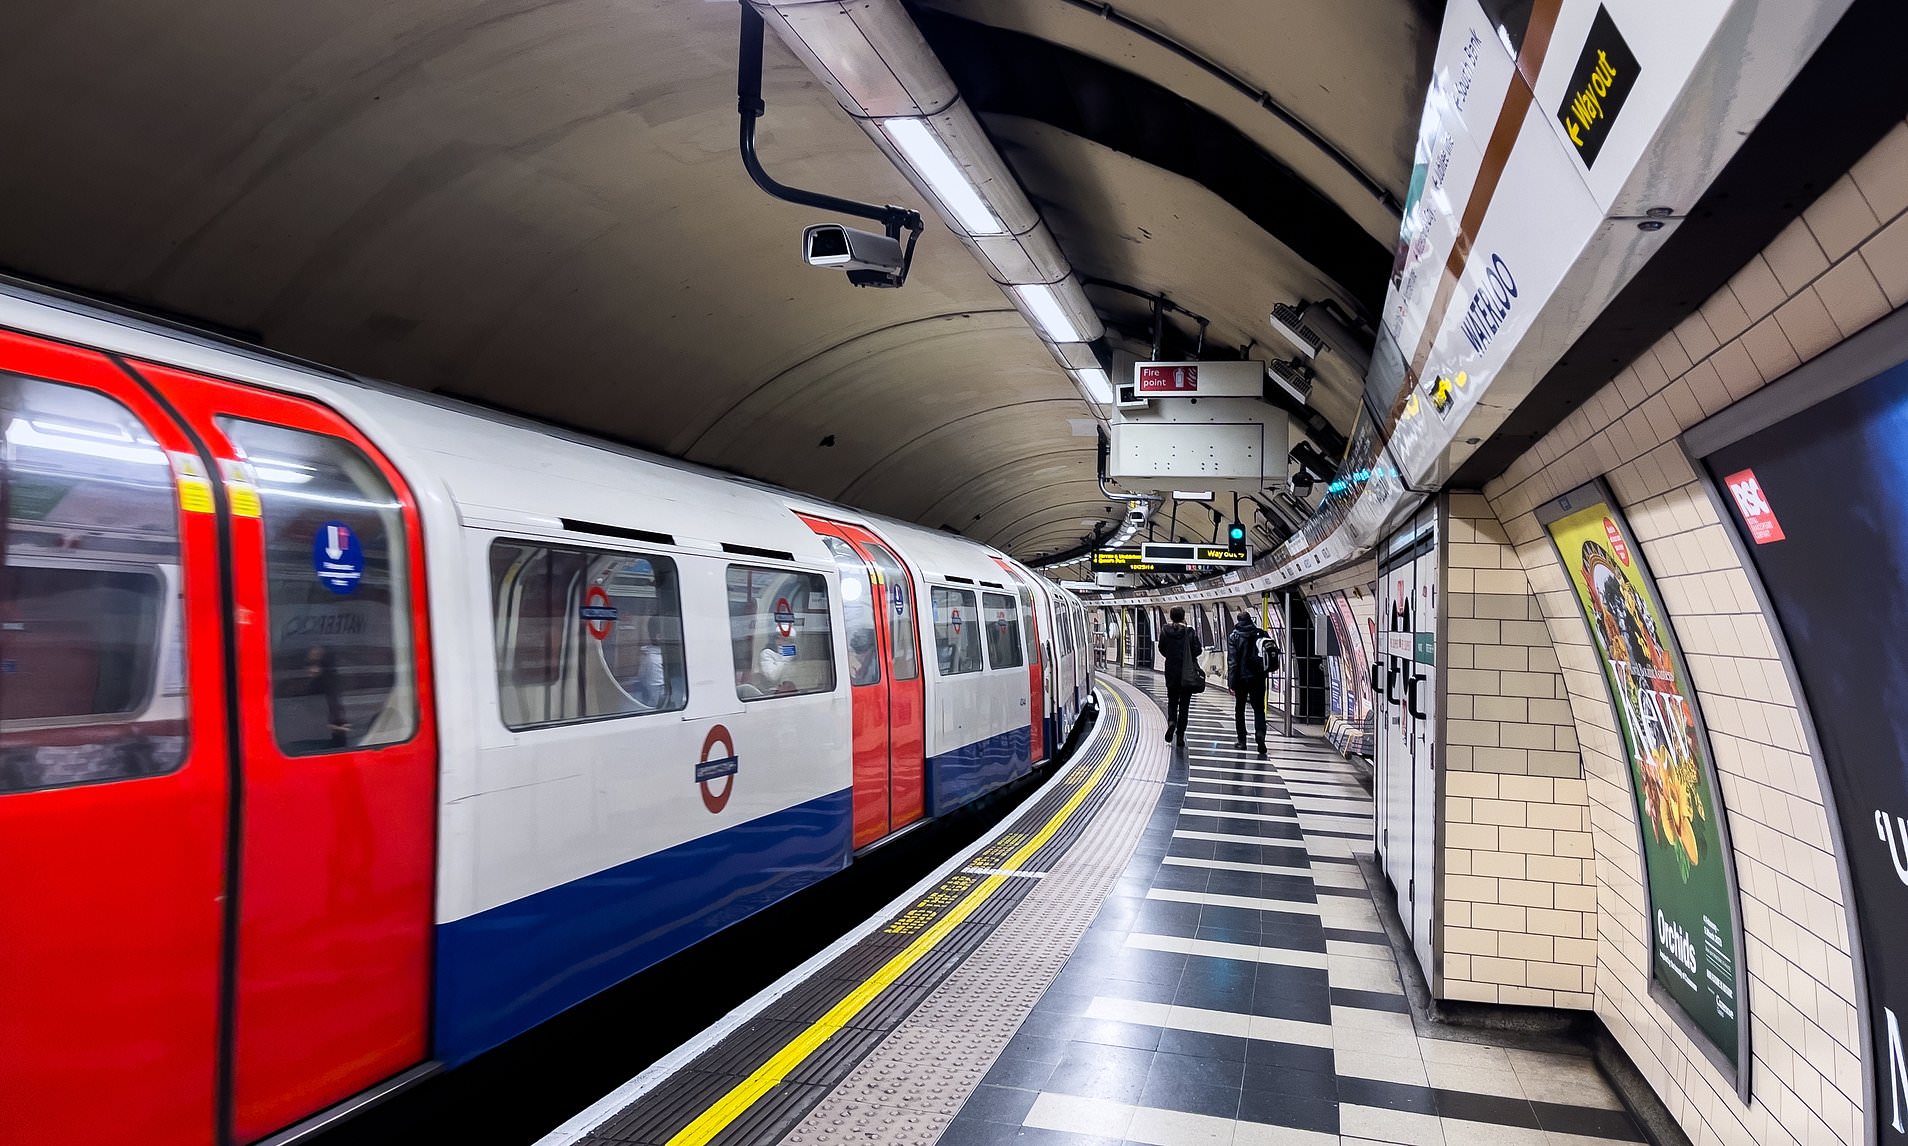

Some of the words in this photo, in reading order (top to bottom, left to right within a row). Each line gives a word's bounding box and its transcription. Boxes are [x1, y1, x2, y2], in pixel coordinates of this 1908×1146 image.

[1463, 27, 1482, 67] Bank
[1571, 82, 1604, 131] Way
[1591, 49, 1617, 98] out
[1461, 253, 1518, 358] WATERLOO
[1143, 368, 1160, 378] Fire
[1143, 378, 1167, 387] point
[1207, 550, 1223, 559] Way
[883, 909, 938, 935] MIND
[940, 875, 976, 892] GAP
[1657, 908, 1697, 974] Orchids
